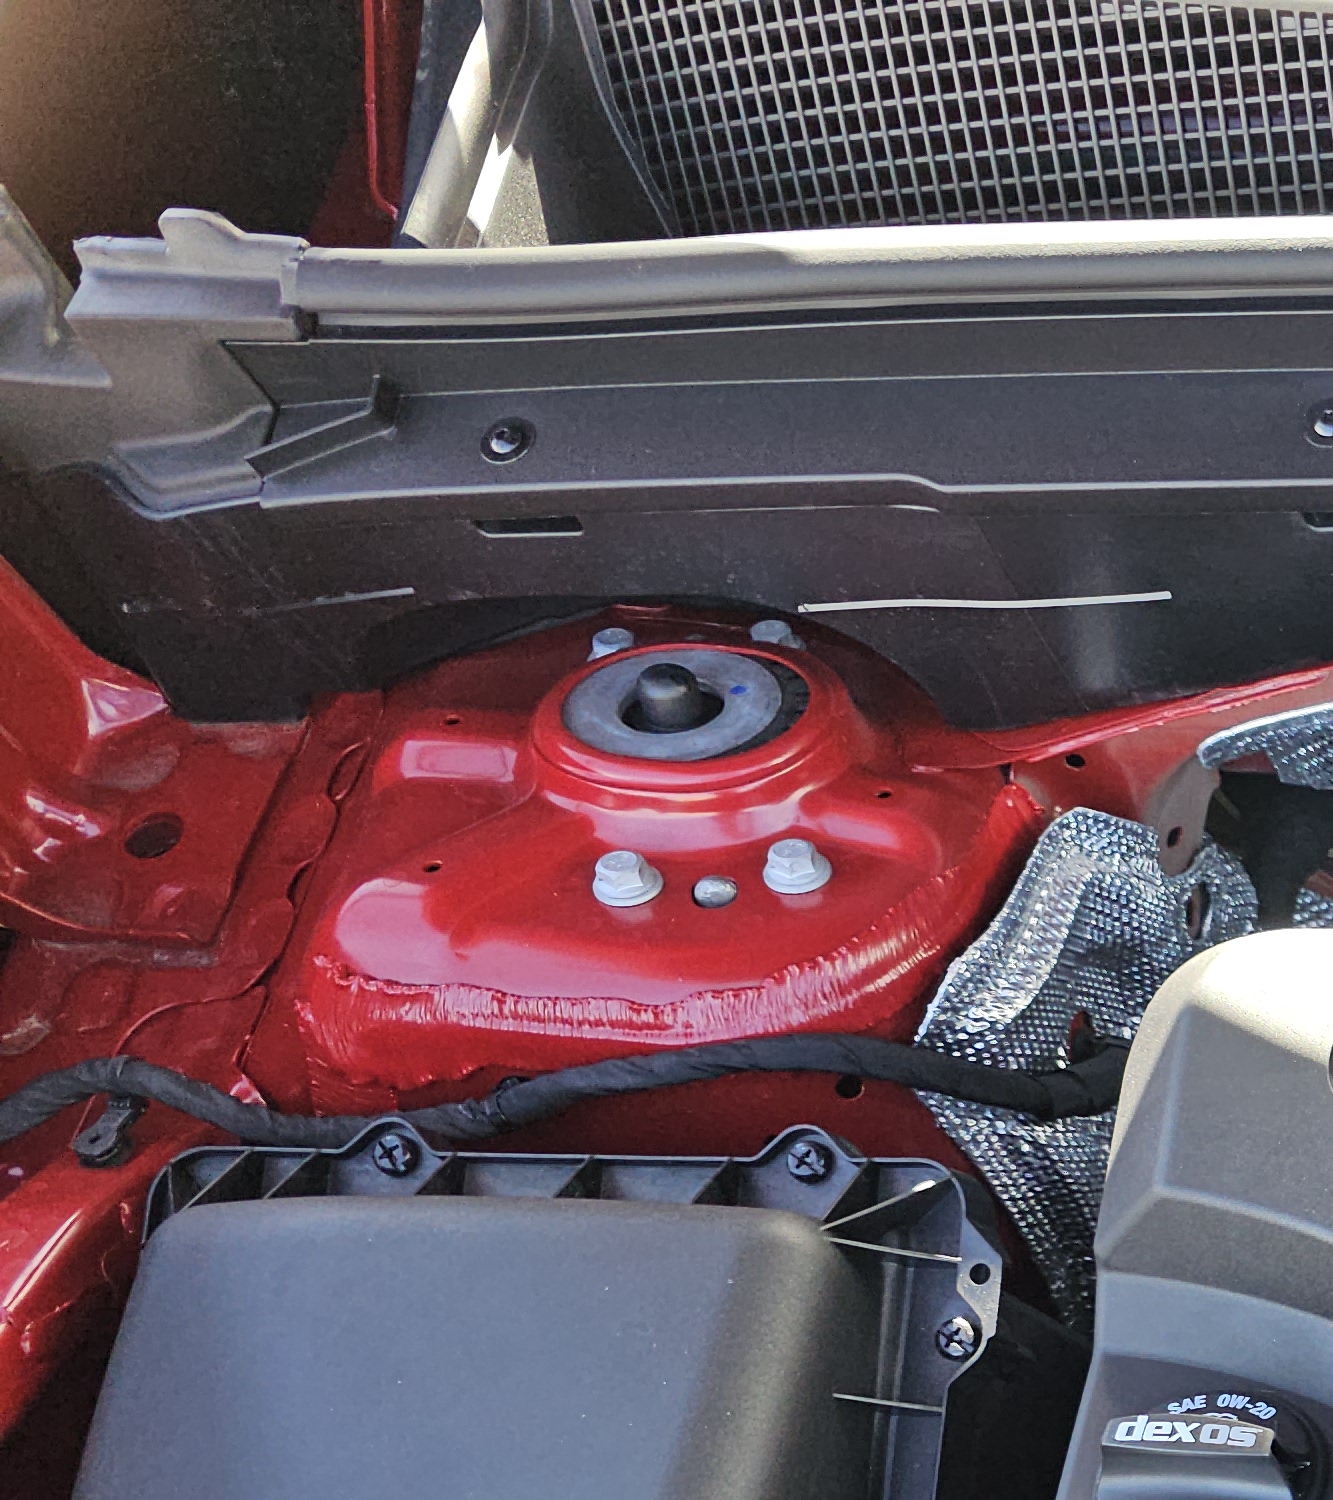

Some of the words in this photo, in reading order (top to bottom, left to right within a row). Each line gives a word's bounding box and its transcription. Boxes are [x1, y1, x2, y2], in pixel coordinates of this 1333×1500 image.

[1167, 1394, 1207, 1415] SAE
[1216, 1392, 1278, 1420] 0W-20
[1114, 1414, 1264, 1448] dexos
